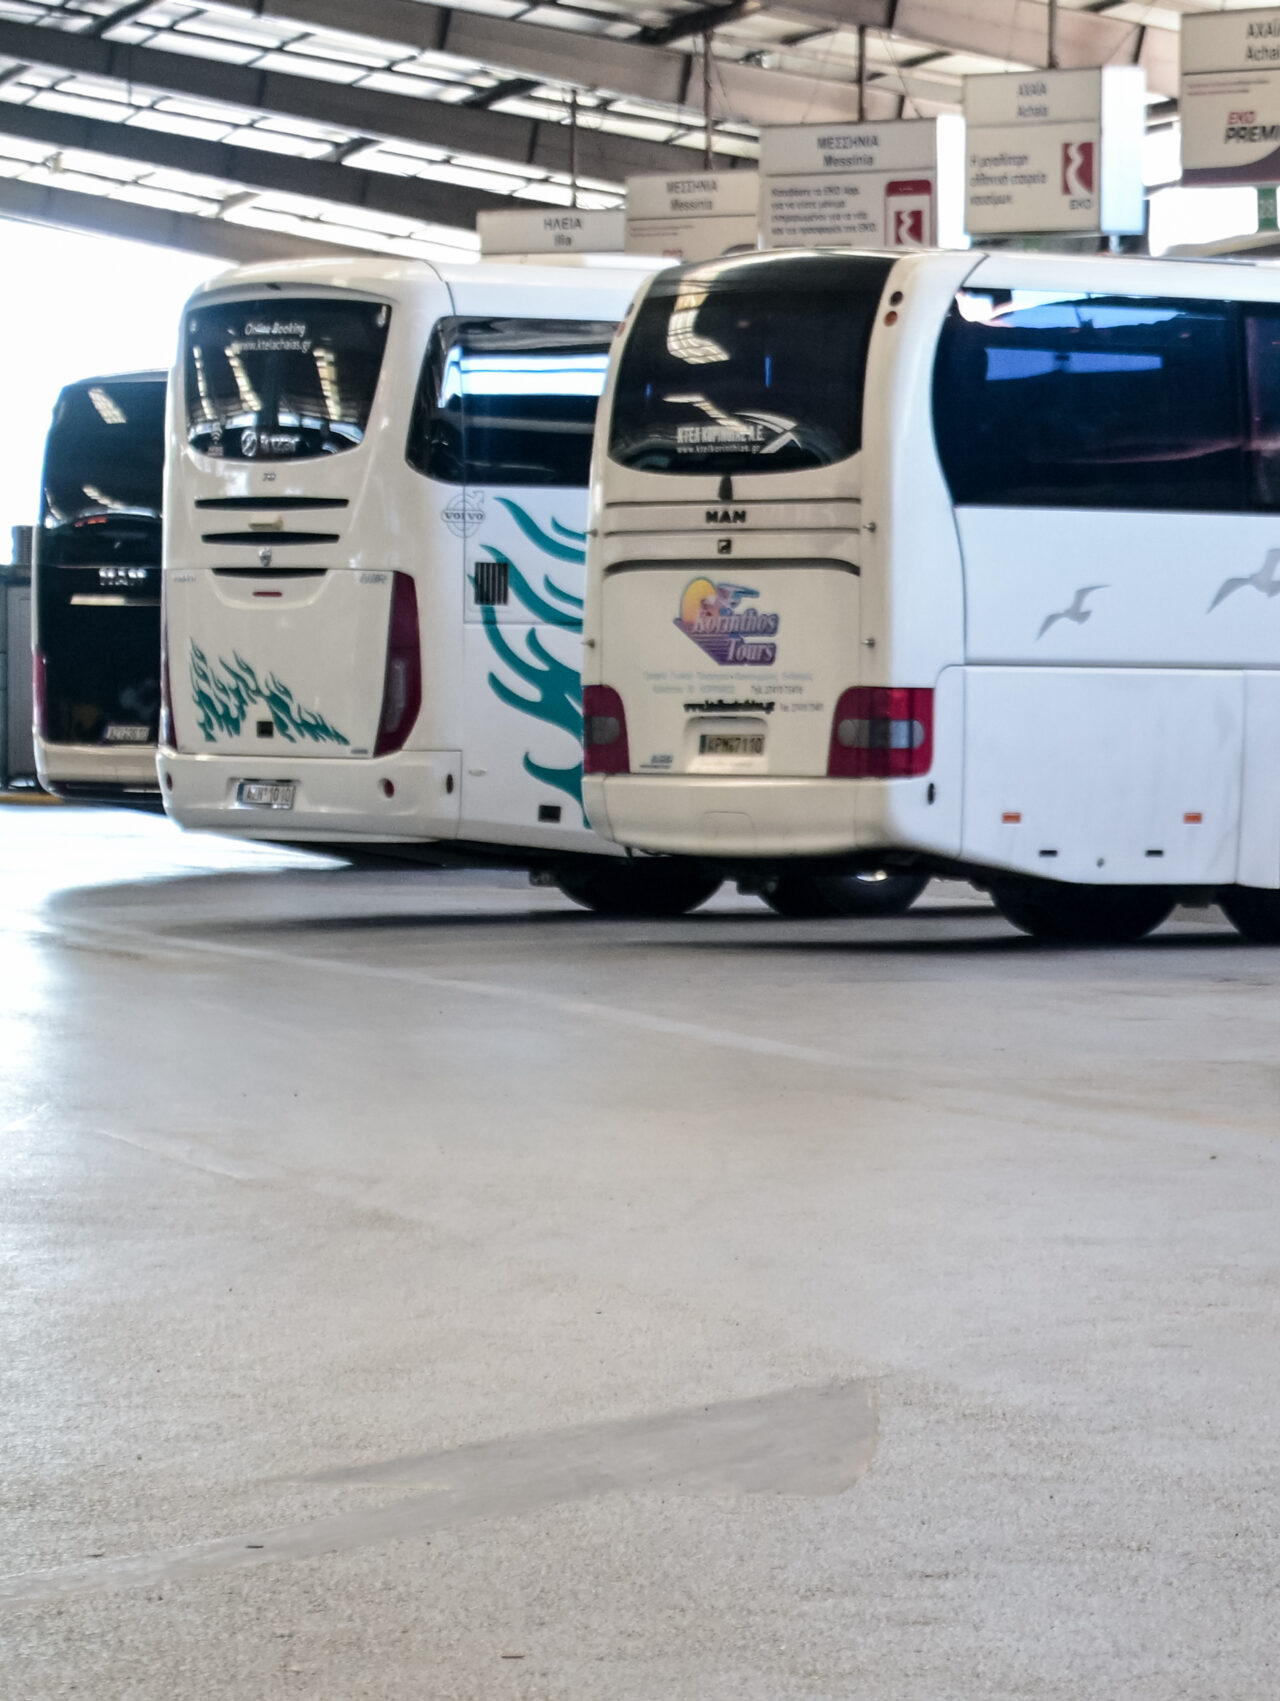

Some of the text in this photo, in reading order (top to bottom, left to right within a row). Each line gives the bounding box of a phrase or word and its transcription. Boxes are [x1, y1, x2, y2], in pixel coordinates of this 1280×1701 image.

[817, 135, 879, 149] ΜΕΣΣΗΝΙΑ
[823, 154, 875, 167] Messinia
[544, 218, 583, 231] ΗΛΕΙΑ
[705, 510, 746, 523] MAN
[693, 609, 778, 634] Korinthos
[727, 638, 775, 662] Tours
